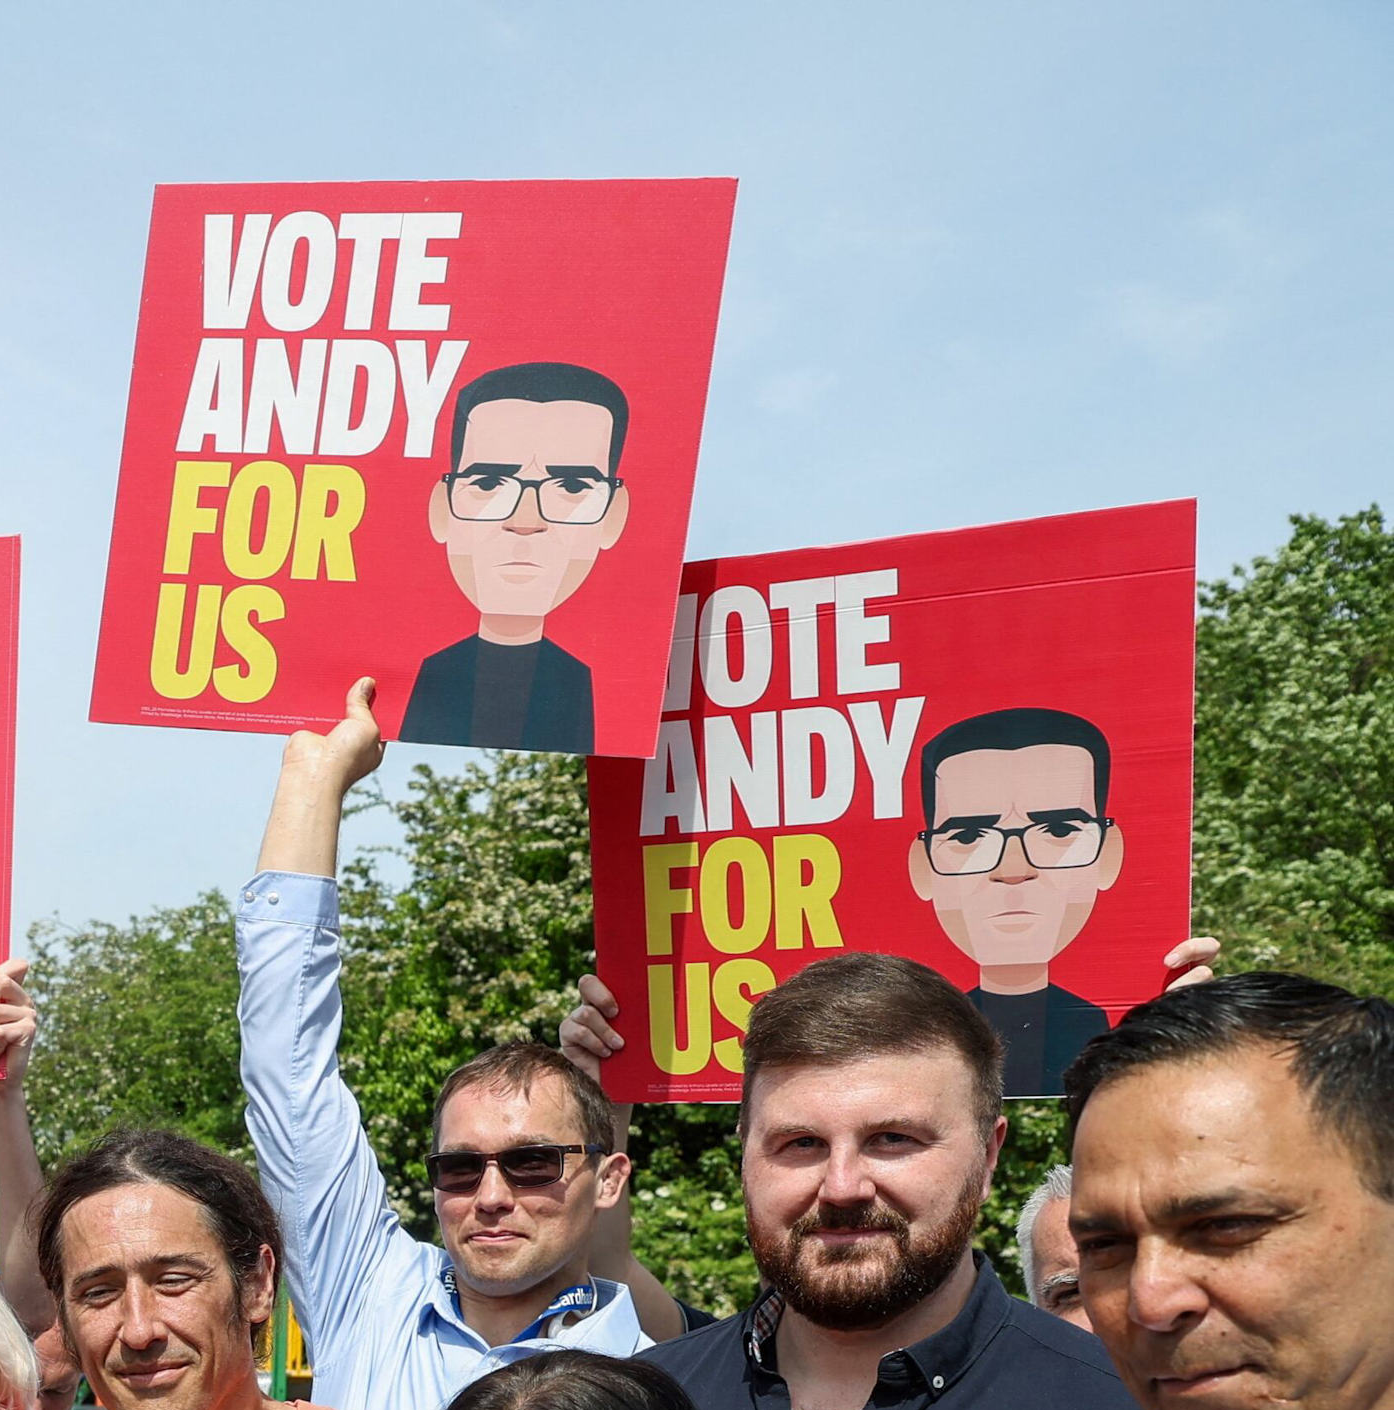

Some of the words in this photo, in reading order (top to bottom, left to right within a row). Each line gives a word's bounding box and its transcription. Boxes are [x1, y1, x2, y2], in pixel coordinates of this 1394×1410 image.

[203, 211, 463, 332] VOTE
[175, 338, 469, 459] ANDY
[162, 461, 366, 582] FOR
[149, 584, 285, 704] US
[638, 696, 926, 836] ANDY
[642, 834, 844, 956] FOR
